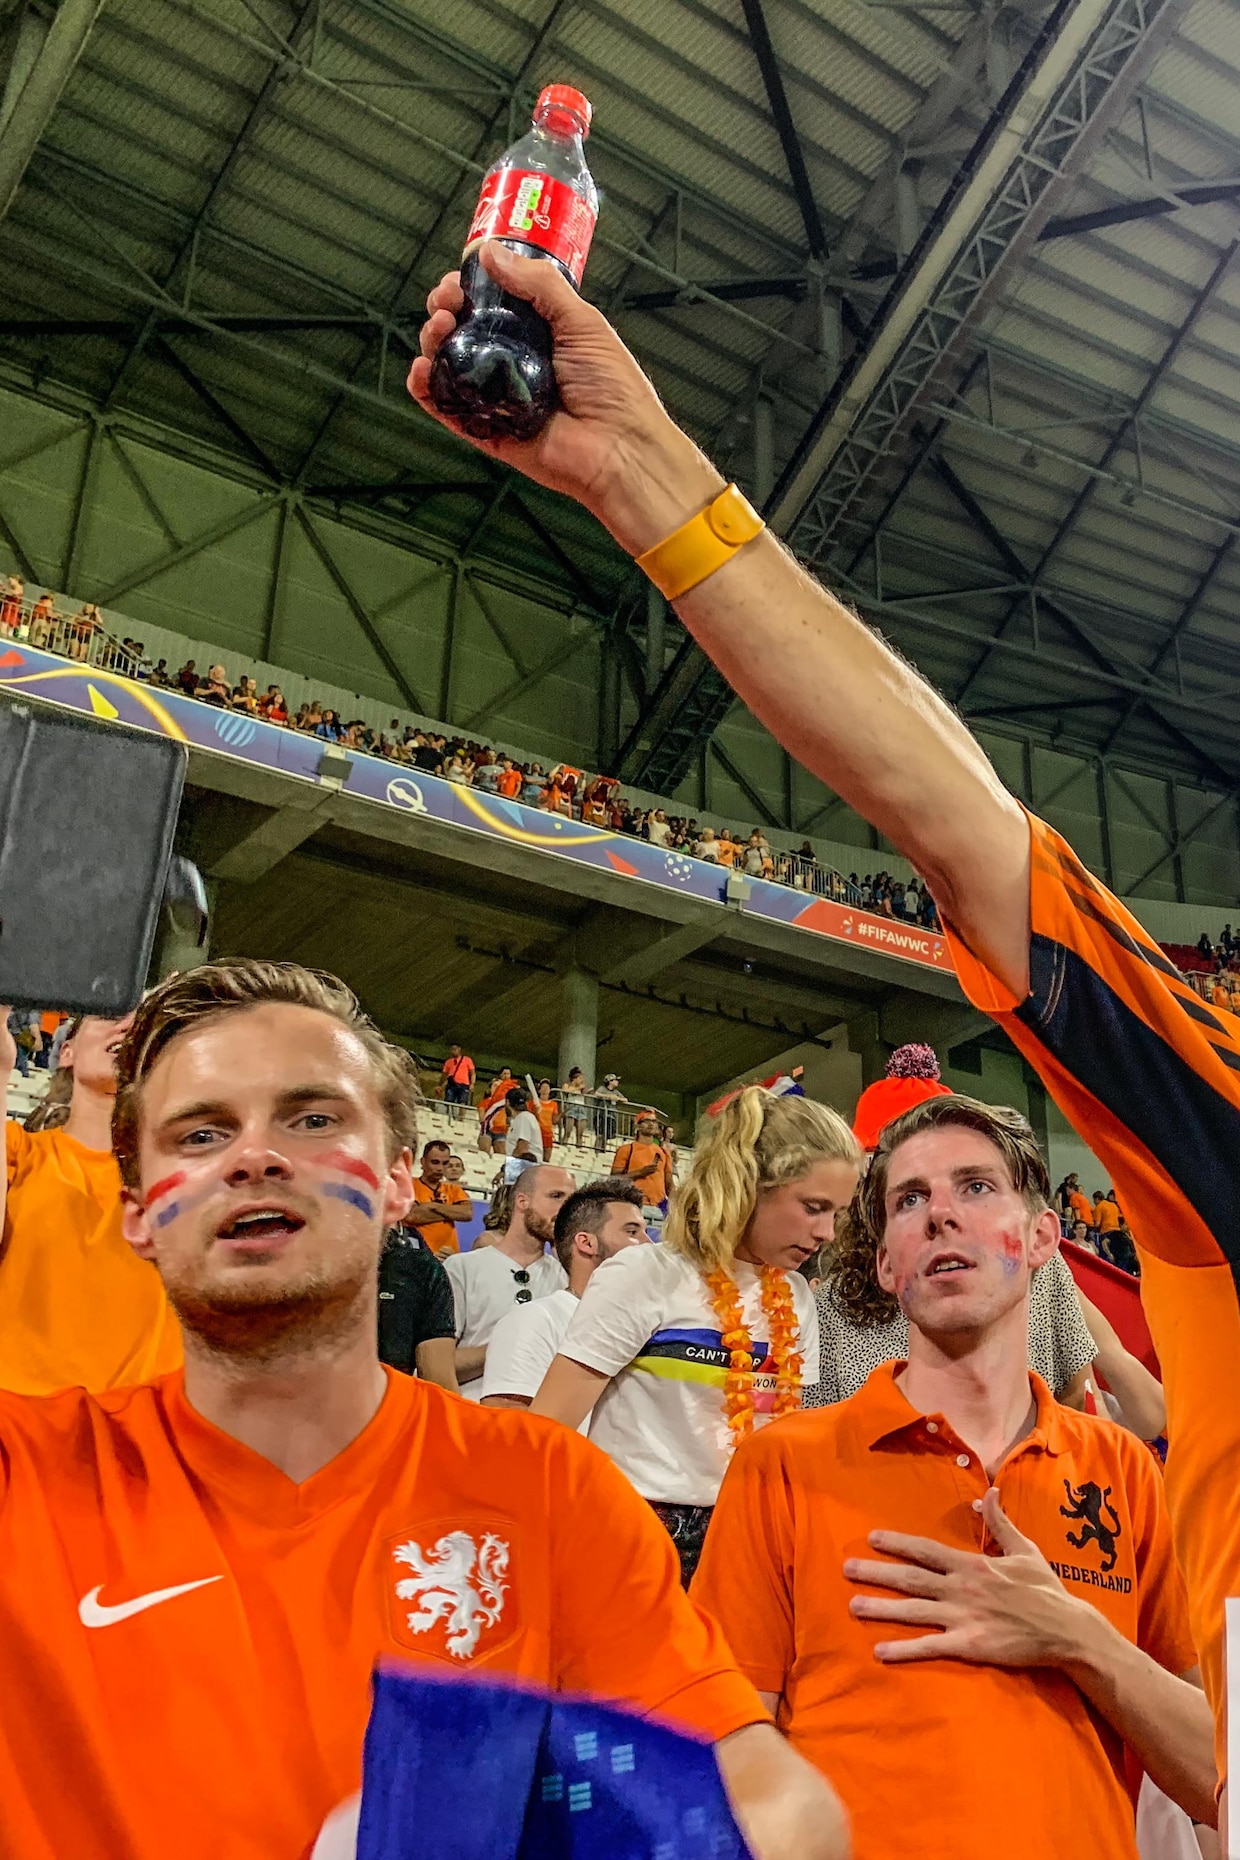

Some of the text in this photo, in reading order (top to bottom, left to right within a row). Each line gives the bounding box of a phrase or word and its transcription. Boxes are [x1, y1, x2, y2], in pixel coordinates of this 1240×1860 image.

[858, 922, 929, 955] #FIFAWWC
[685, 1346, 728, 1363] CAN'T
[1049, 1561, 1132, 1594] NEDERLAND
